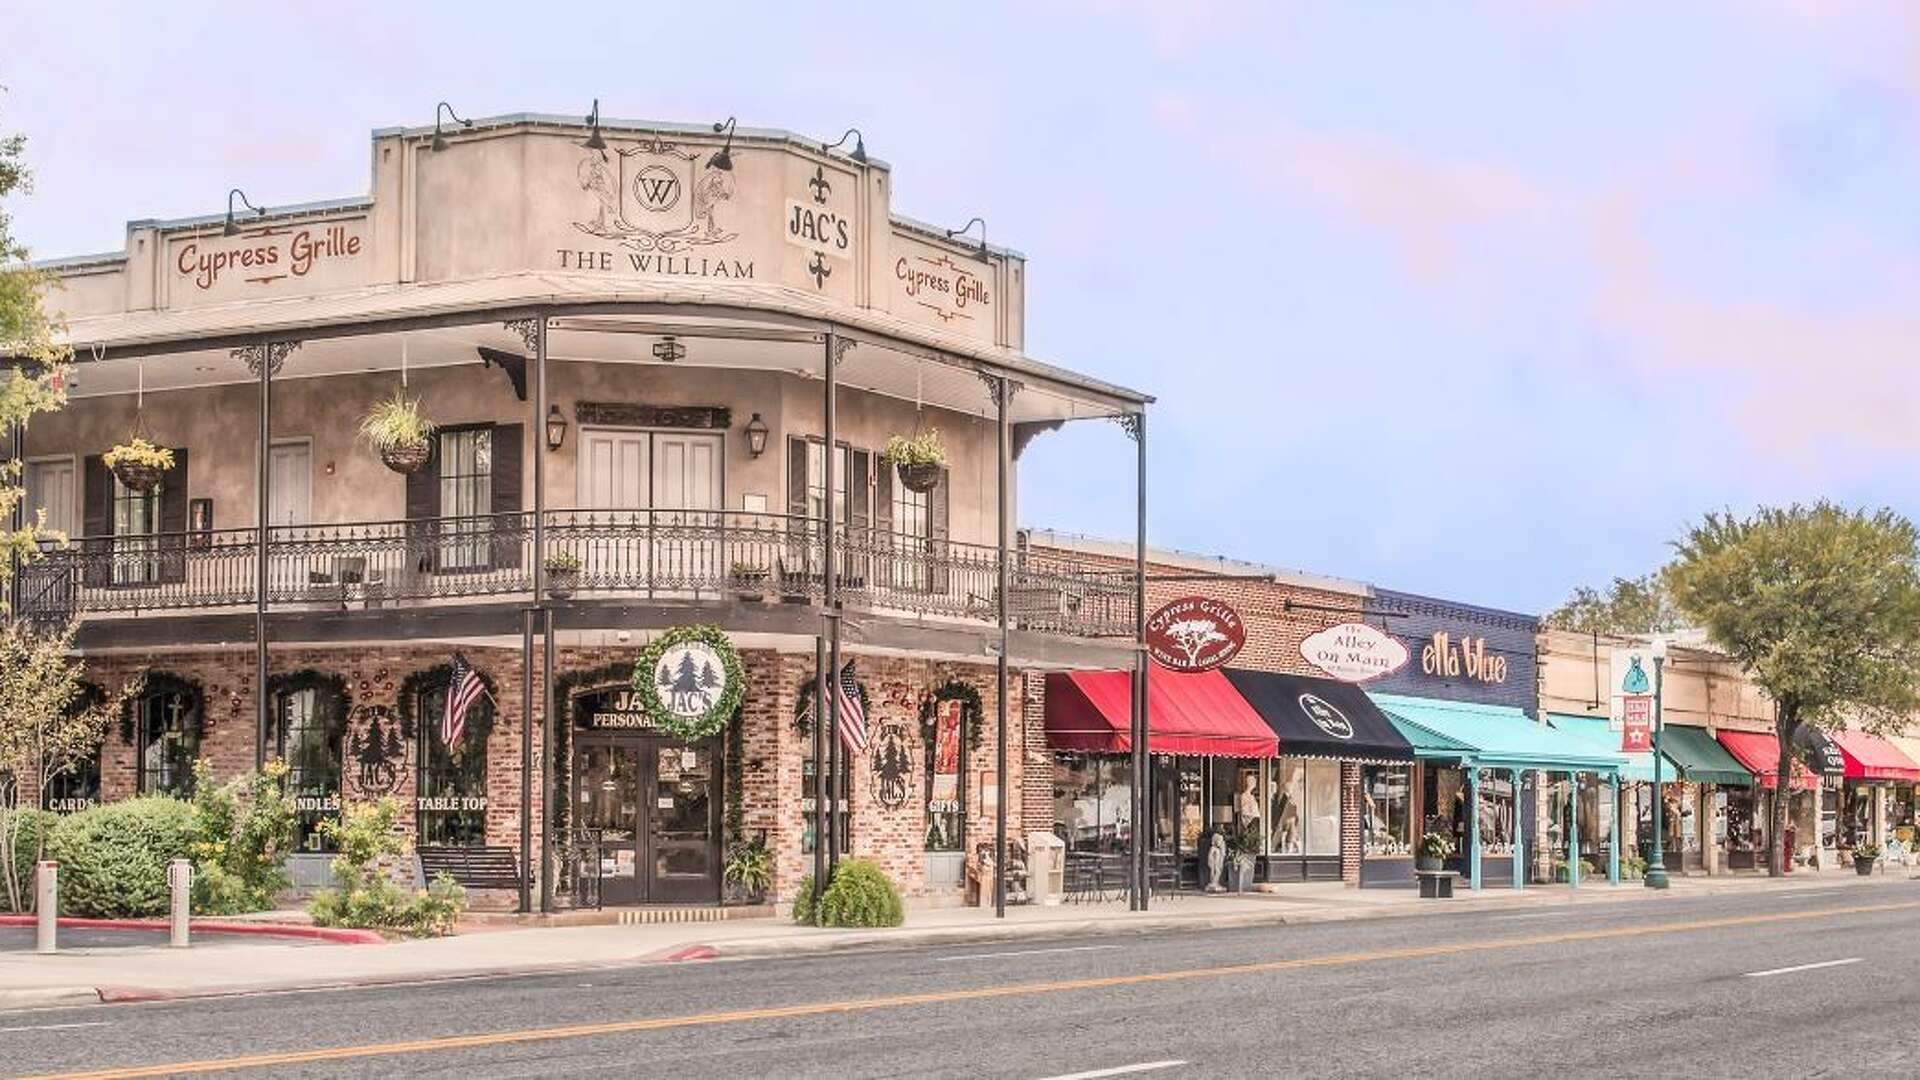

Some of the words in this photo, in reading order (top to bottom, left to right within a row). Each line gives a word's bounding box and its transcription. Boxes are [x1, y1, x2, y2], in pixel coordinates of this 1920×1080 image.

[639, 178, 675, 204] W
[790, 205, 849, 249] JAC'S
[178, 244, 279, 289] Cypress
[290, 227, 362, 276] Grille
[557, 249, 613, 271] THE
[628, 254, 755, 279] WILLIAM
[895, 257, 950, 296] Cypress
[956, 275, 990, 308] Grille
[1149, 602, 1195, 632] Cypress
[1200, 601, 1237, 629] Grille
[1335, 636, 1376, 650] Alley
[1423, 631, 1460, 676] ella
[1462, 636, 1507, 683] blue
[1346, 653, 1390, 668] Main
[615, 692, 644, 711] JA
[417, 797, 459, 811] TABLE
[461, 797, 488, 811] TOP
[929, 799, 960, 812] GIFTS
